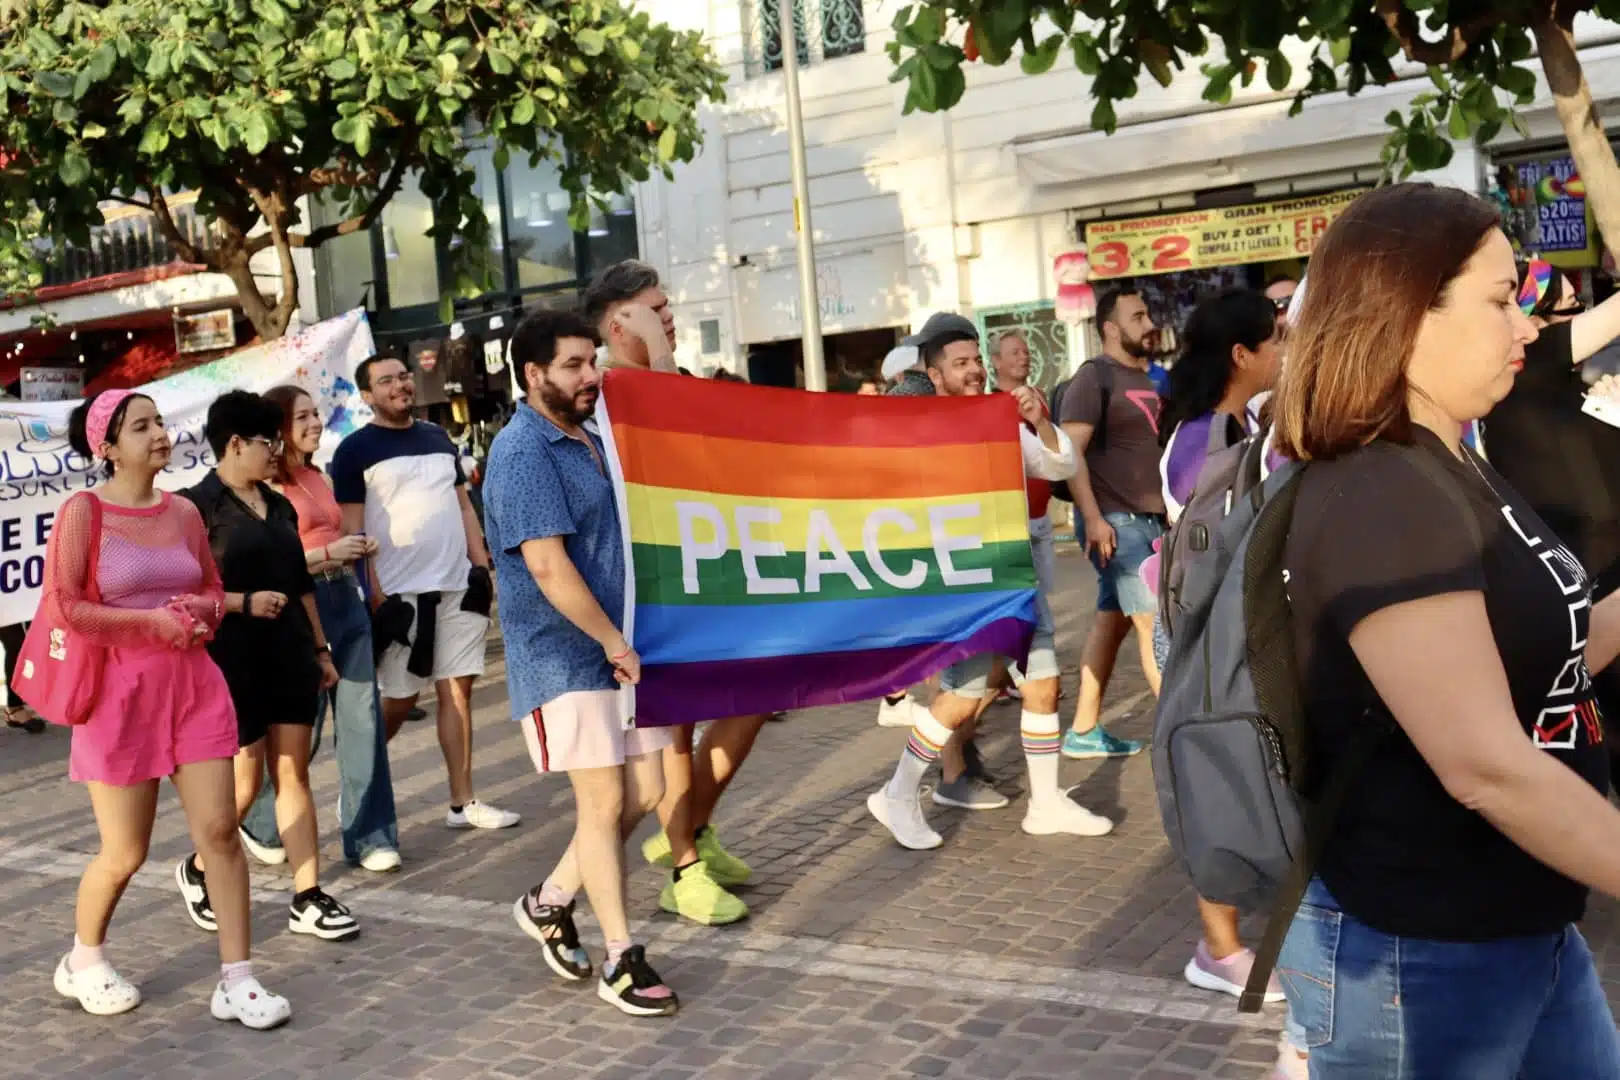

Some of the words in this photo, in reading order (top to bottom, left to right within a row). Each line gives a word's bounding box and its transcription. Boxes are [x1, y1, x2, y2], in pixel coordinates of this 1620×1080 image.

[1223, 205, 1266, 219] GRAN
[1119, 214, 1209, 232] PROMOTION
[1202, 230, 1228, 242] BUY
[1231, 227, 1241, 239] 2
[1245, 223, 1271, 236] GET
[1538, 222, 1587, 244] RATIS!
[1091, 241, 1131, 277] 3
[1151, 234, 1193, 272] 2
[675, 500, 994, 596] PEACE
